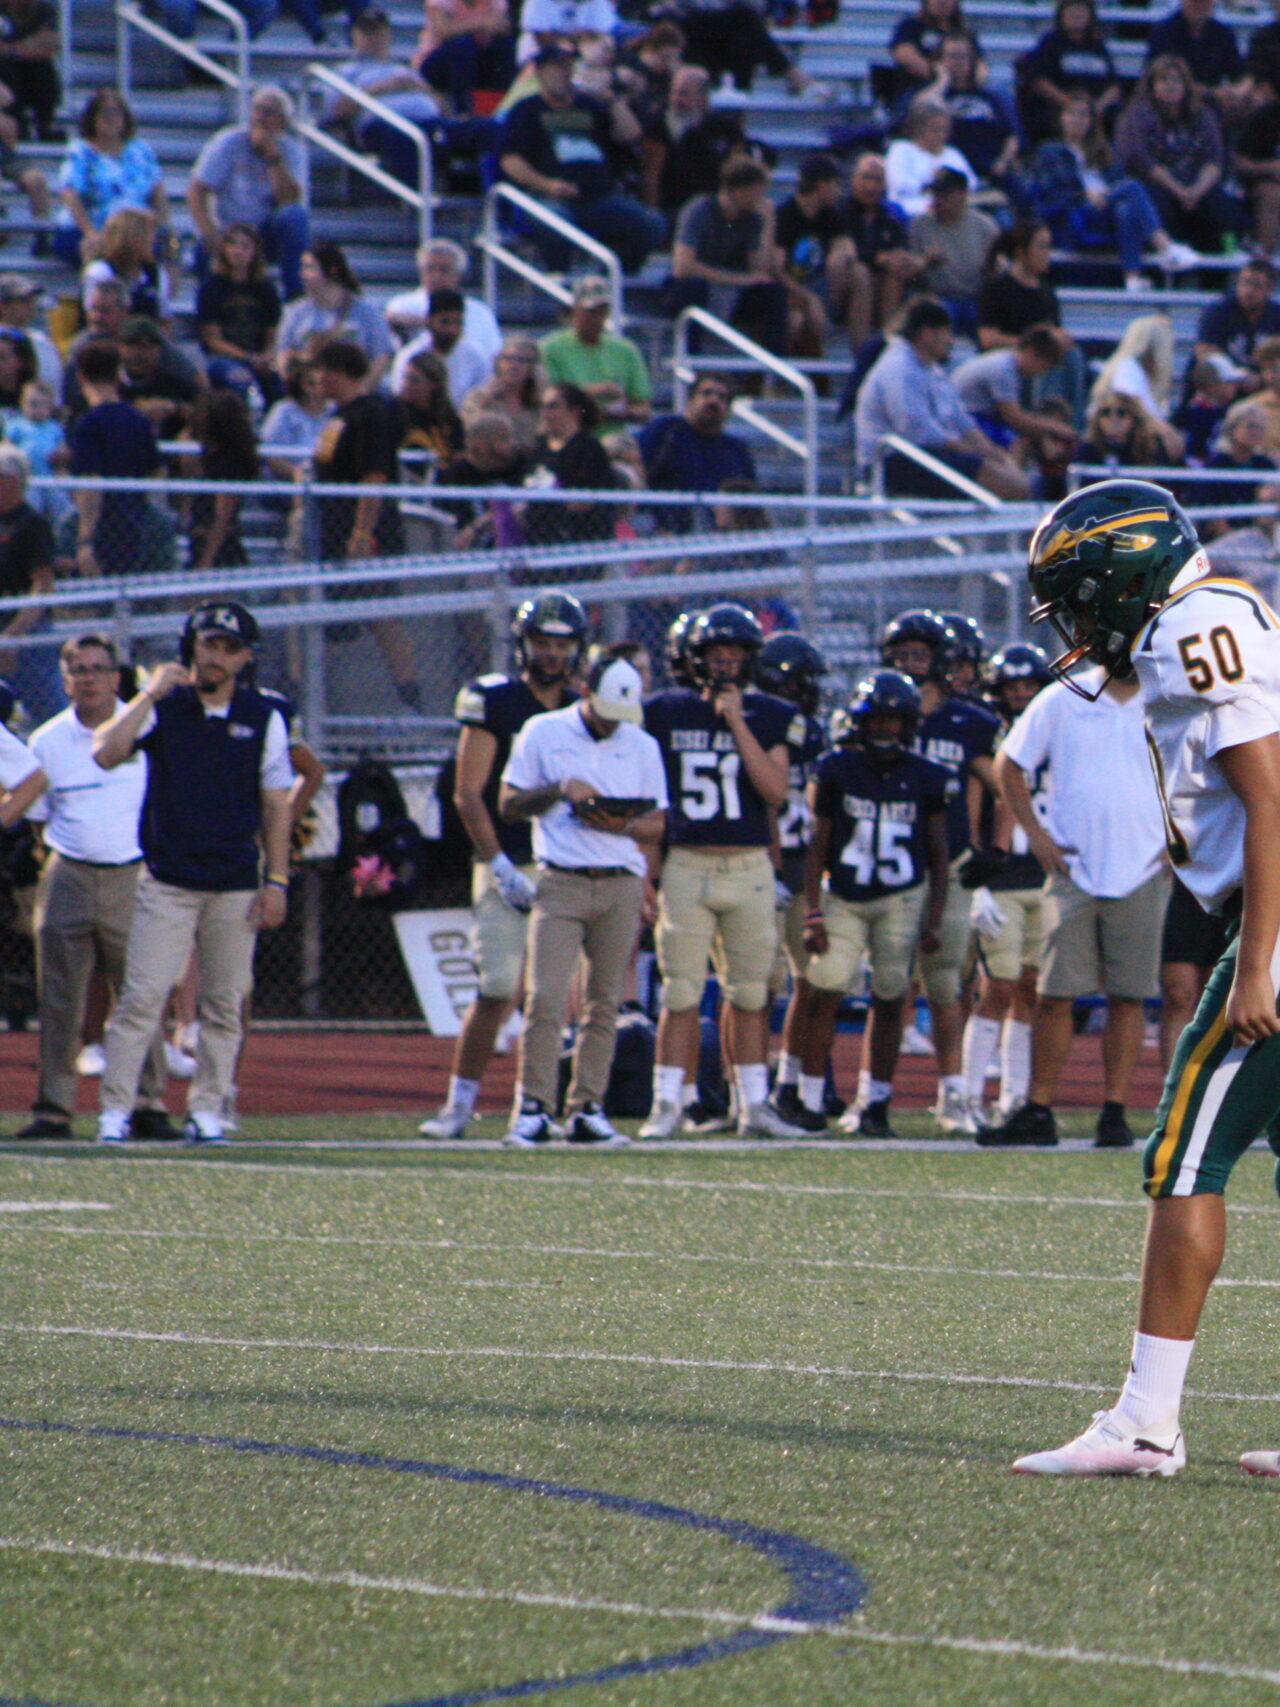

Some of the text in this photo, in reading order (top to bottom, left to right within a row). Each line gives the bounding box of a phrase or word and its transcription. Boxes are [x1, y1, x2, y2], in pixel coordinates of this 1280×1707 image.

[1177, 624, 1244, 694] 50
[680, 751, 742, 821] 51
[839, 819, 915, 887] 45
